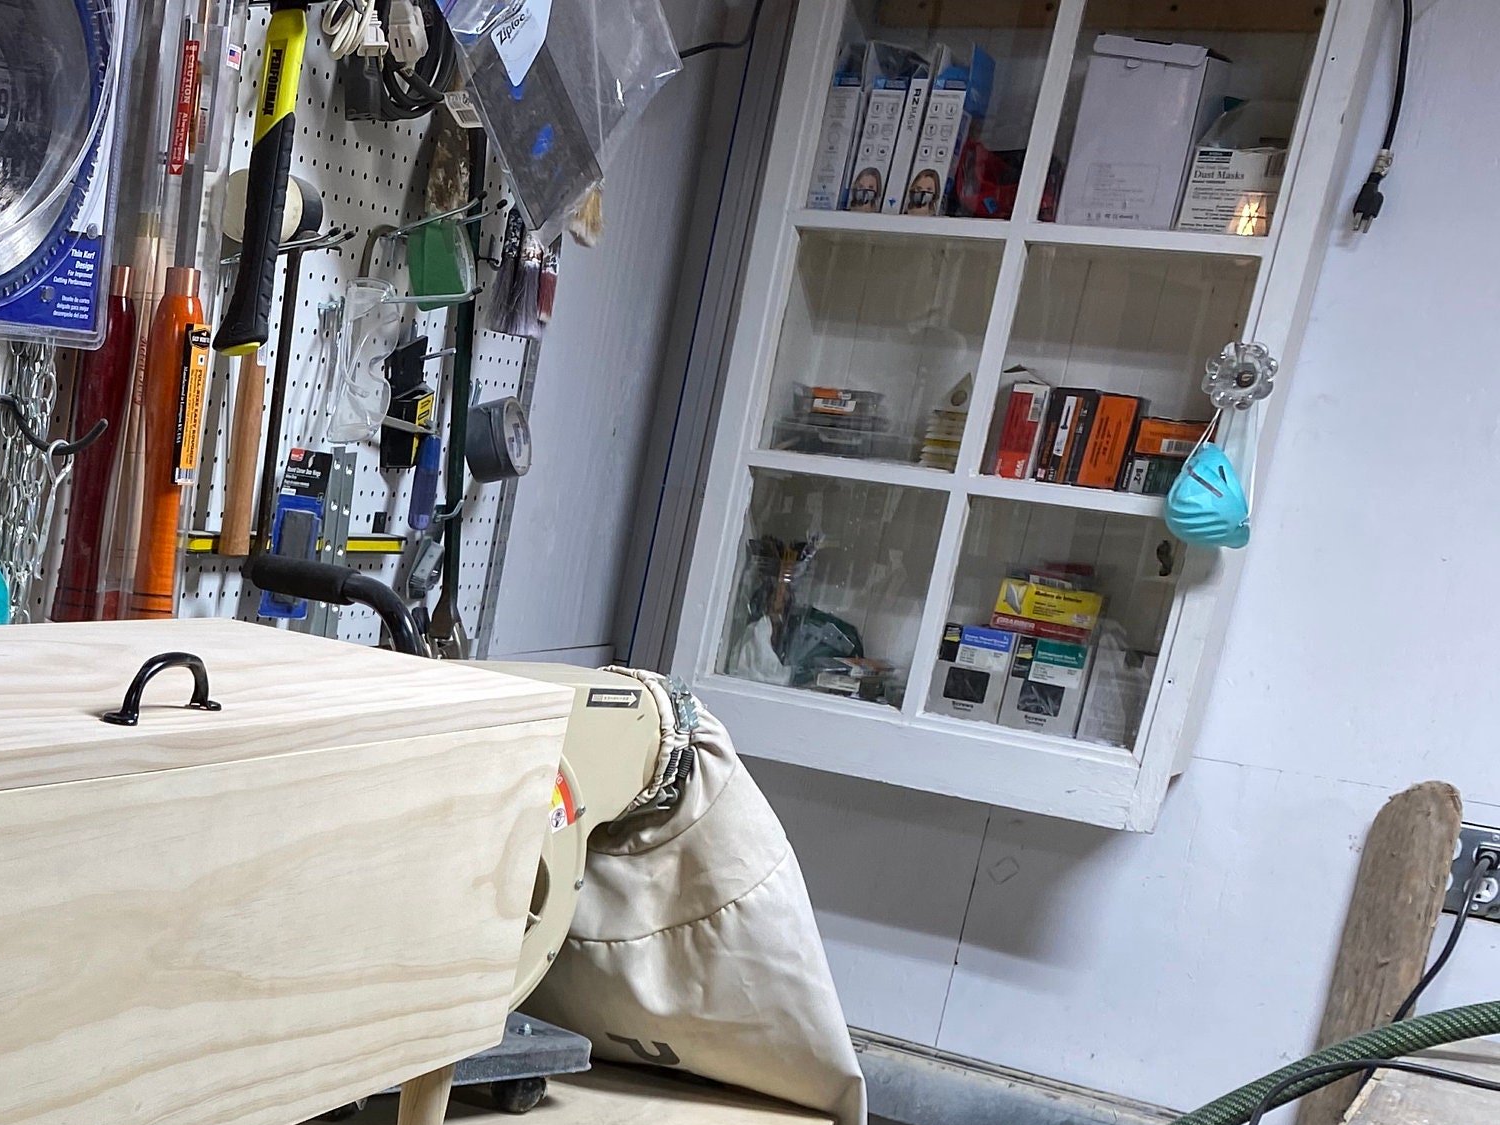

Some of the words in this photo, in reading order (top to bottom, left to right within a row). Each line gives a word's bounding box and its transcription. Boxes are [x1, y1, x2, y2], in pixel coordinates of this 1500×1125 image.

[496, 13, 526, 46] Ziploc
[184, 55, 195, 104] CAUTION
[1194, 170, 1215, 179] Dust
[1218, 170, 1245, 180] Masks
[83, 251, 96, 260] Kerf
[75, 260, 94, 272] Design
